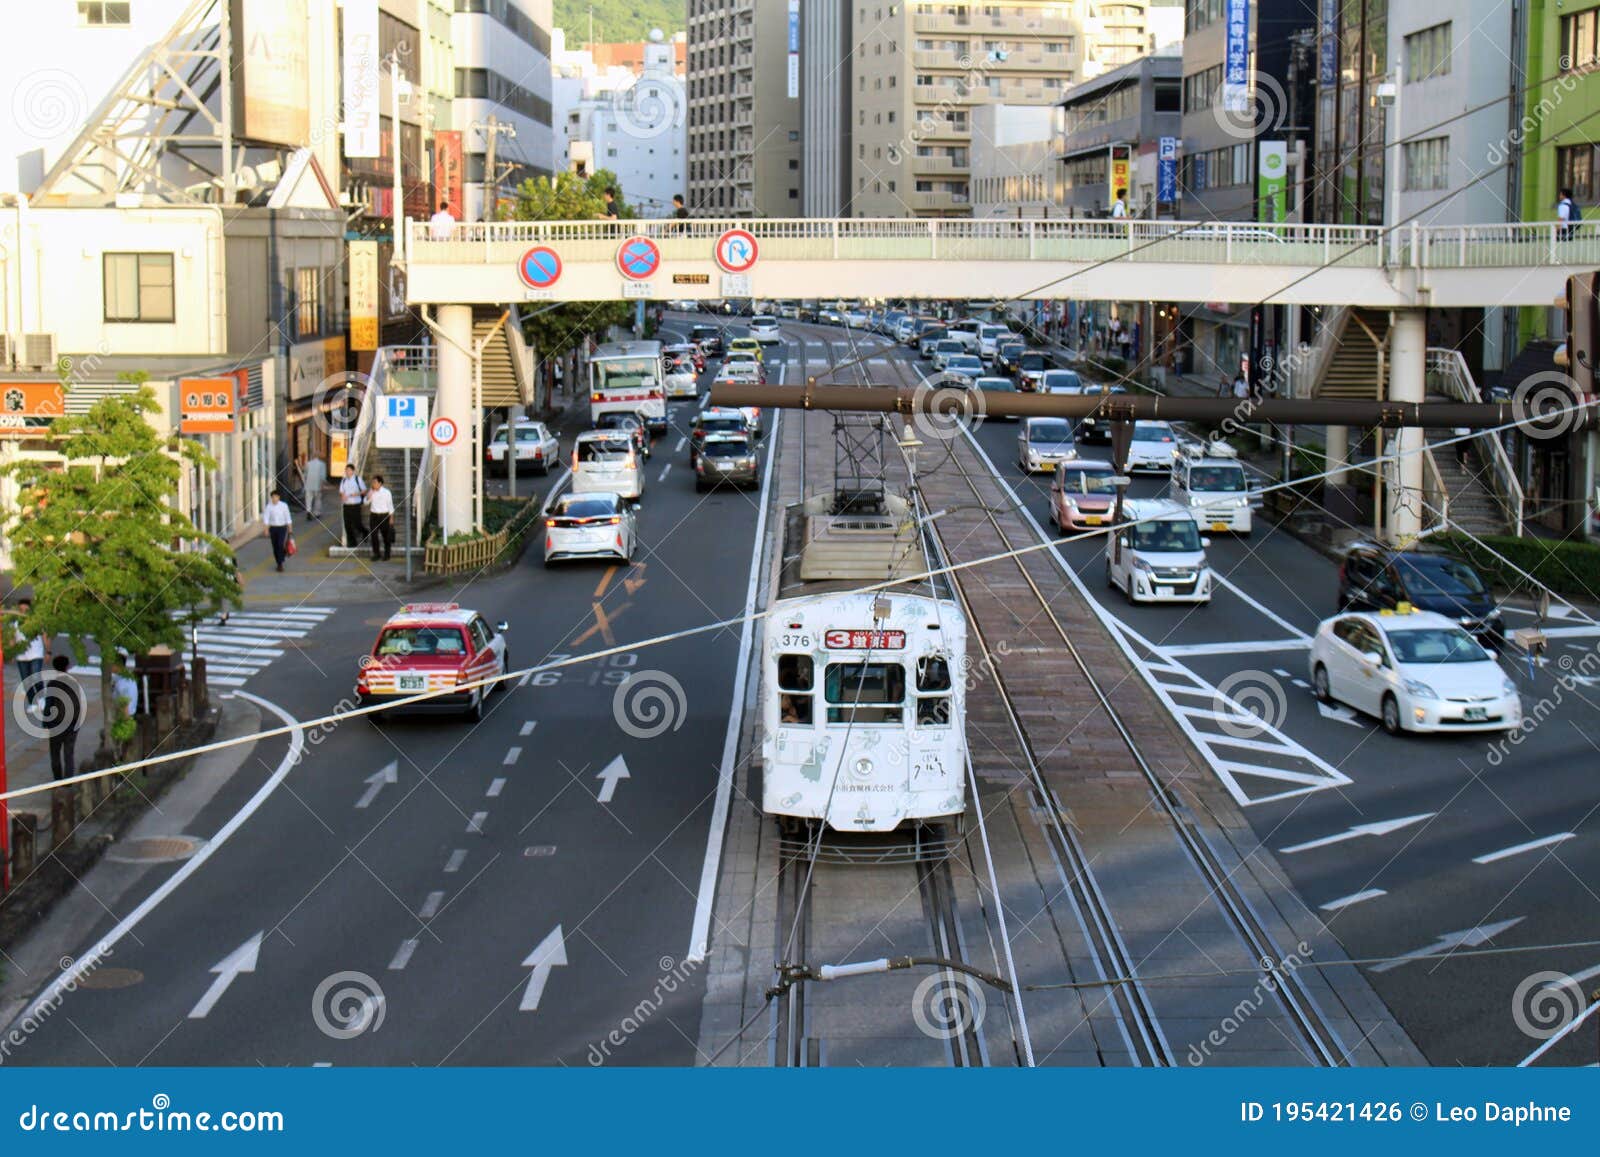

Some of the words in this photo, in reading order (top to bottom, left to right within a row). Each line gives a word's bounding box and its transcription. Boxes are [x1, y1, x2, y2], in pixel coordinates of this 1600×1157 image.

[395, 399, 409, 417] P
[436, 425, 452, 438] 40
[782, 634, 810, 647] 376
[827, 630, 851, 648] 3
